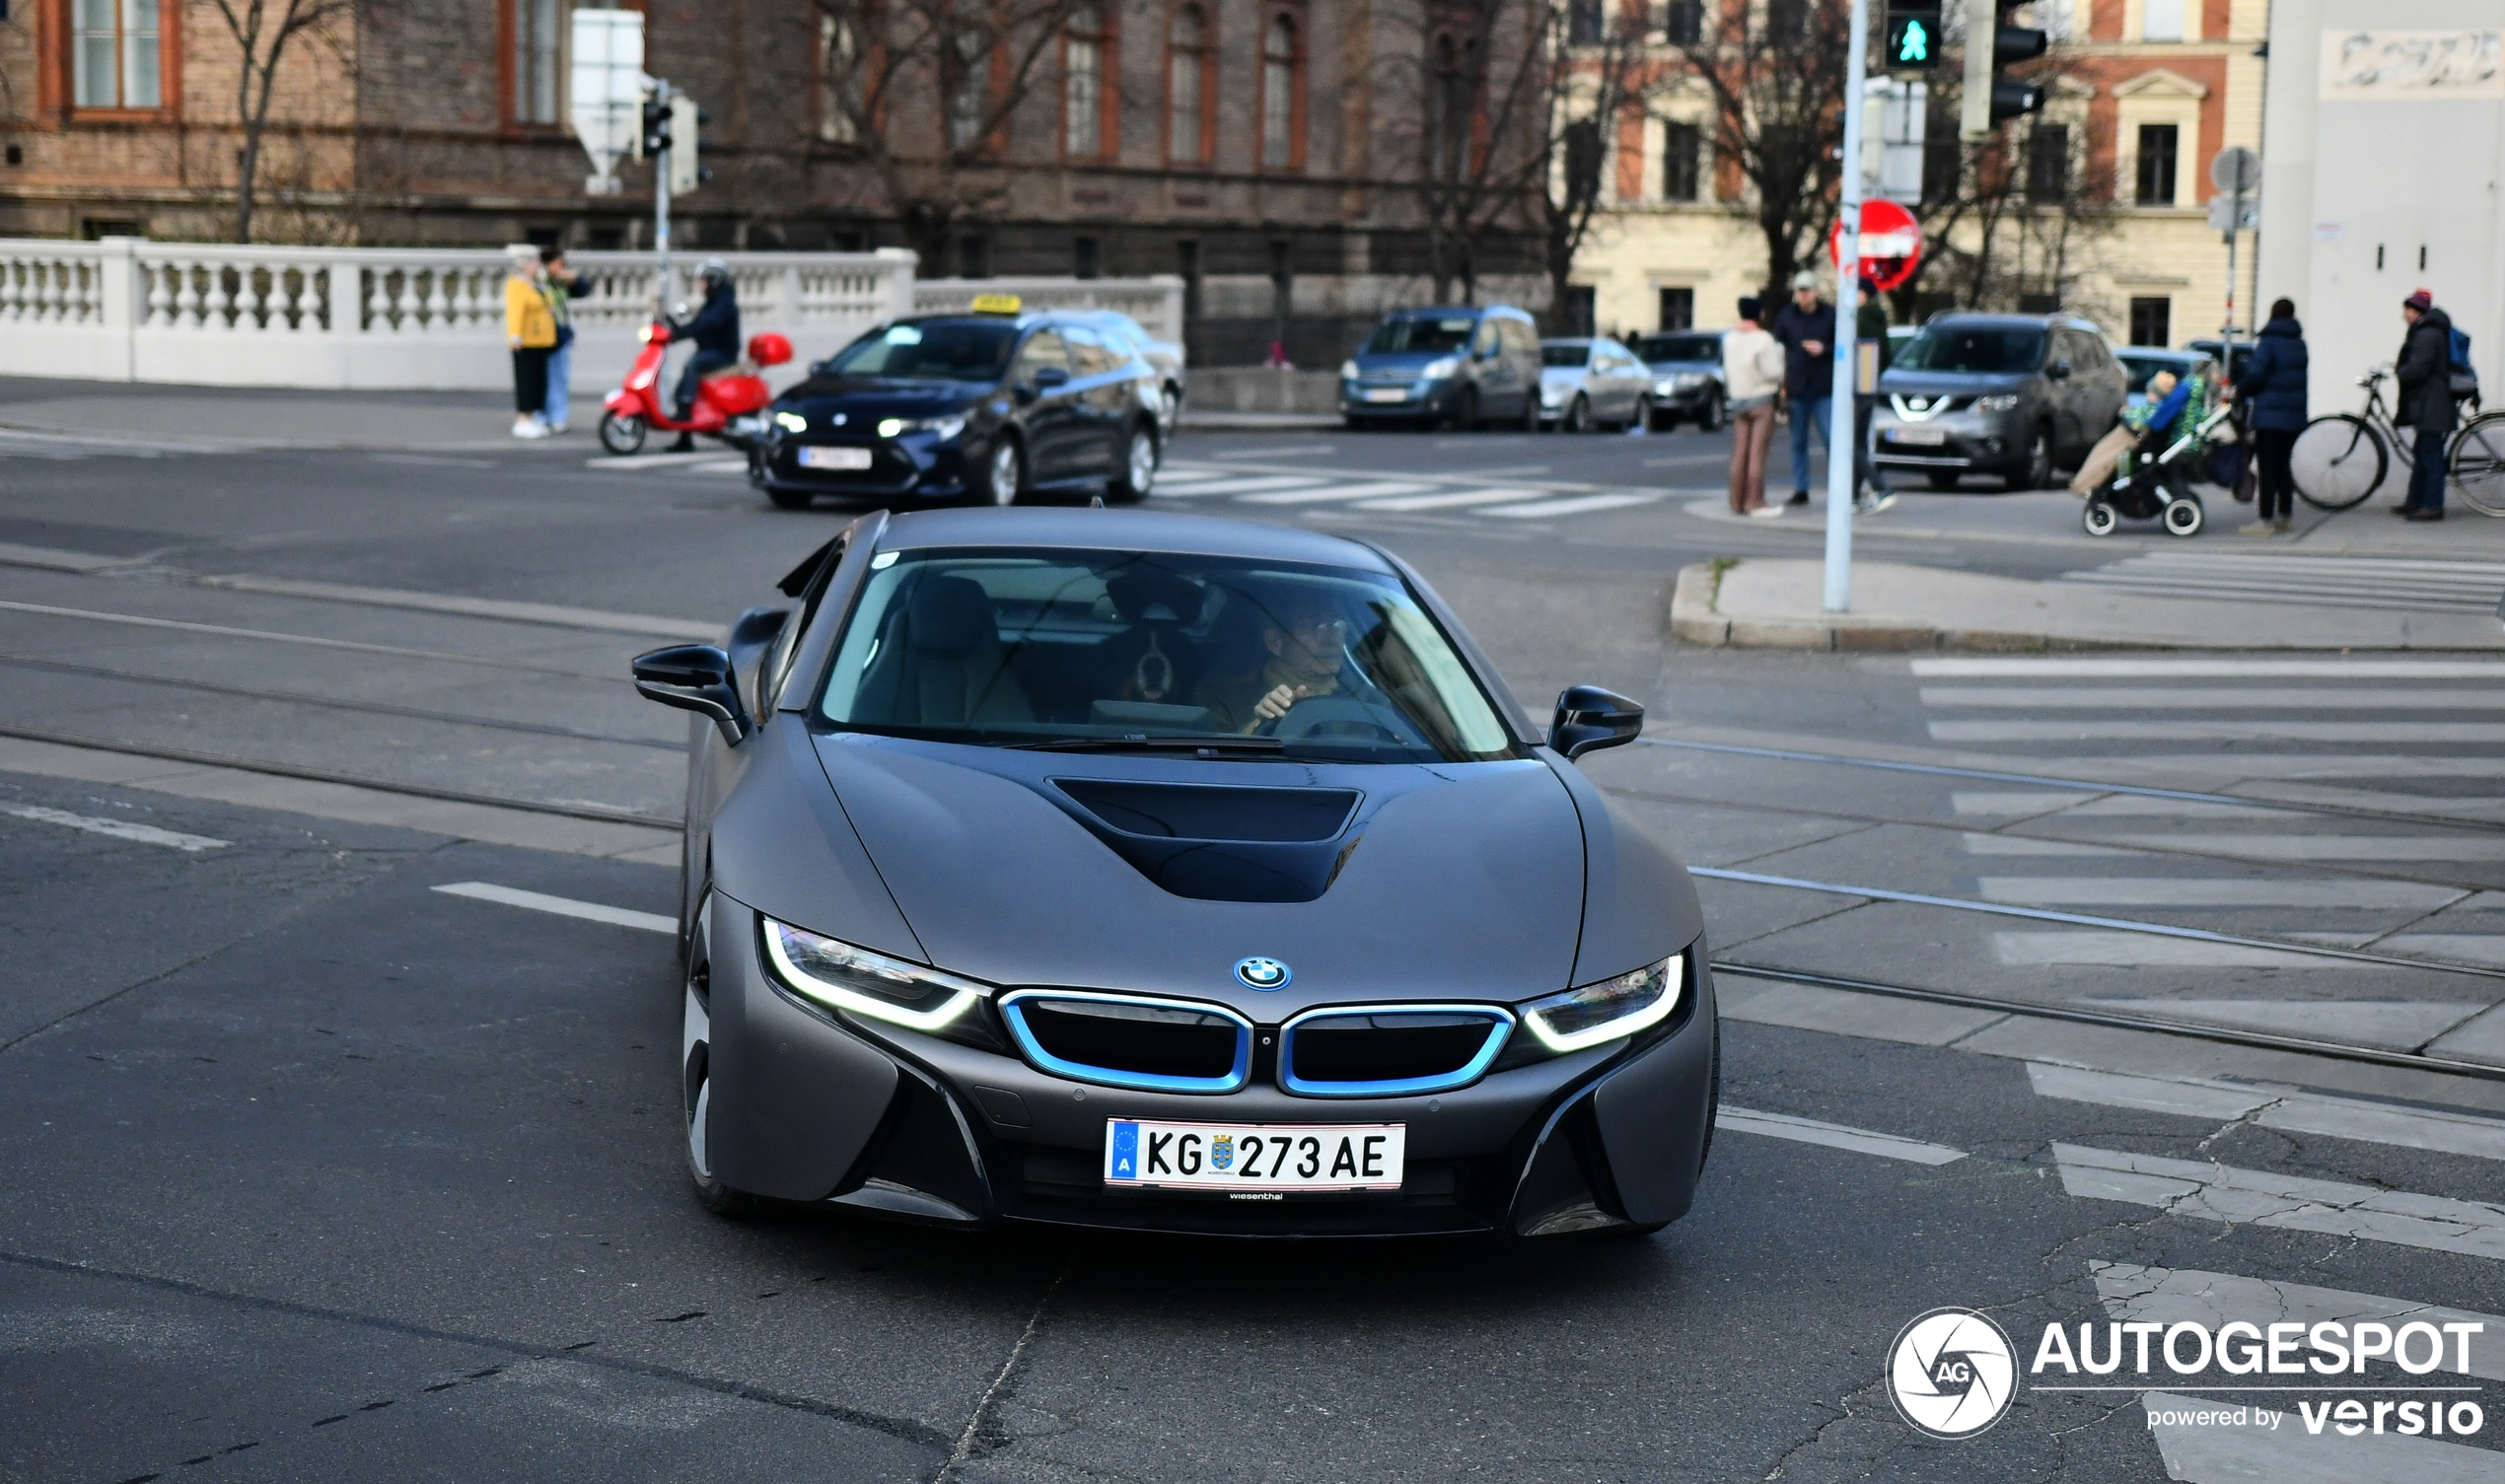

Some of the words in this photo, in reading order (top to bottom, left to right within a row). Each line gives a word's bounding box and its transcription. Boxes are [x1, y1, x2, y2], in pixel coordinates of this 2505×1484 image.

[1147, 1131, 1202, 1175] KG
[1238, 1135, 1321, 1178] 273
[1329, 1135, 1387, 1178] AE
[1117, 1158, 1130, 1171] A
[1229, 1192, 1284, 1201] wiesenthal
